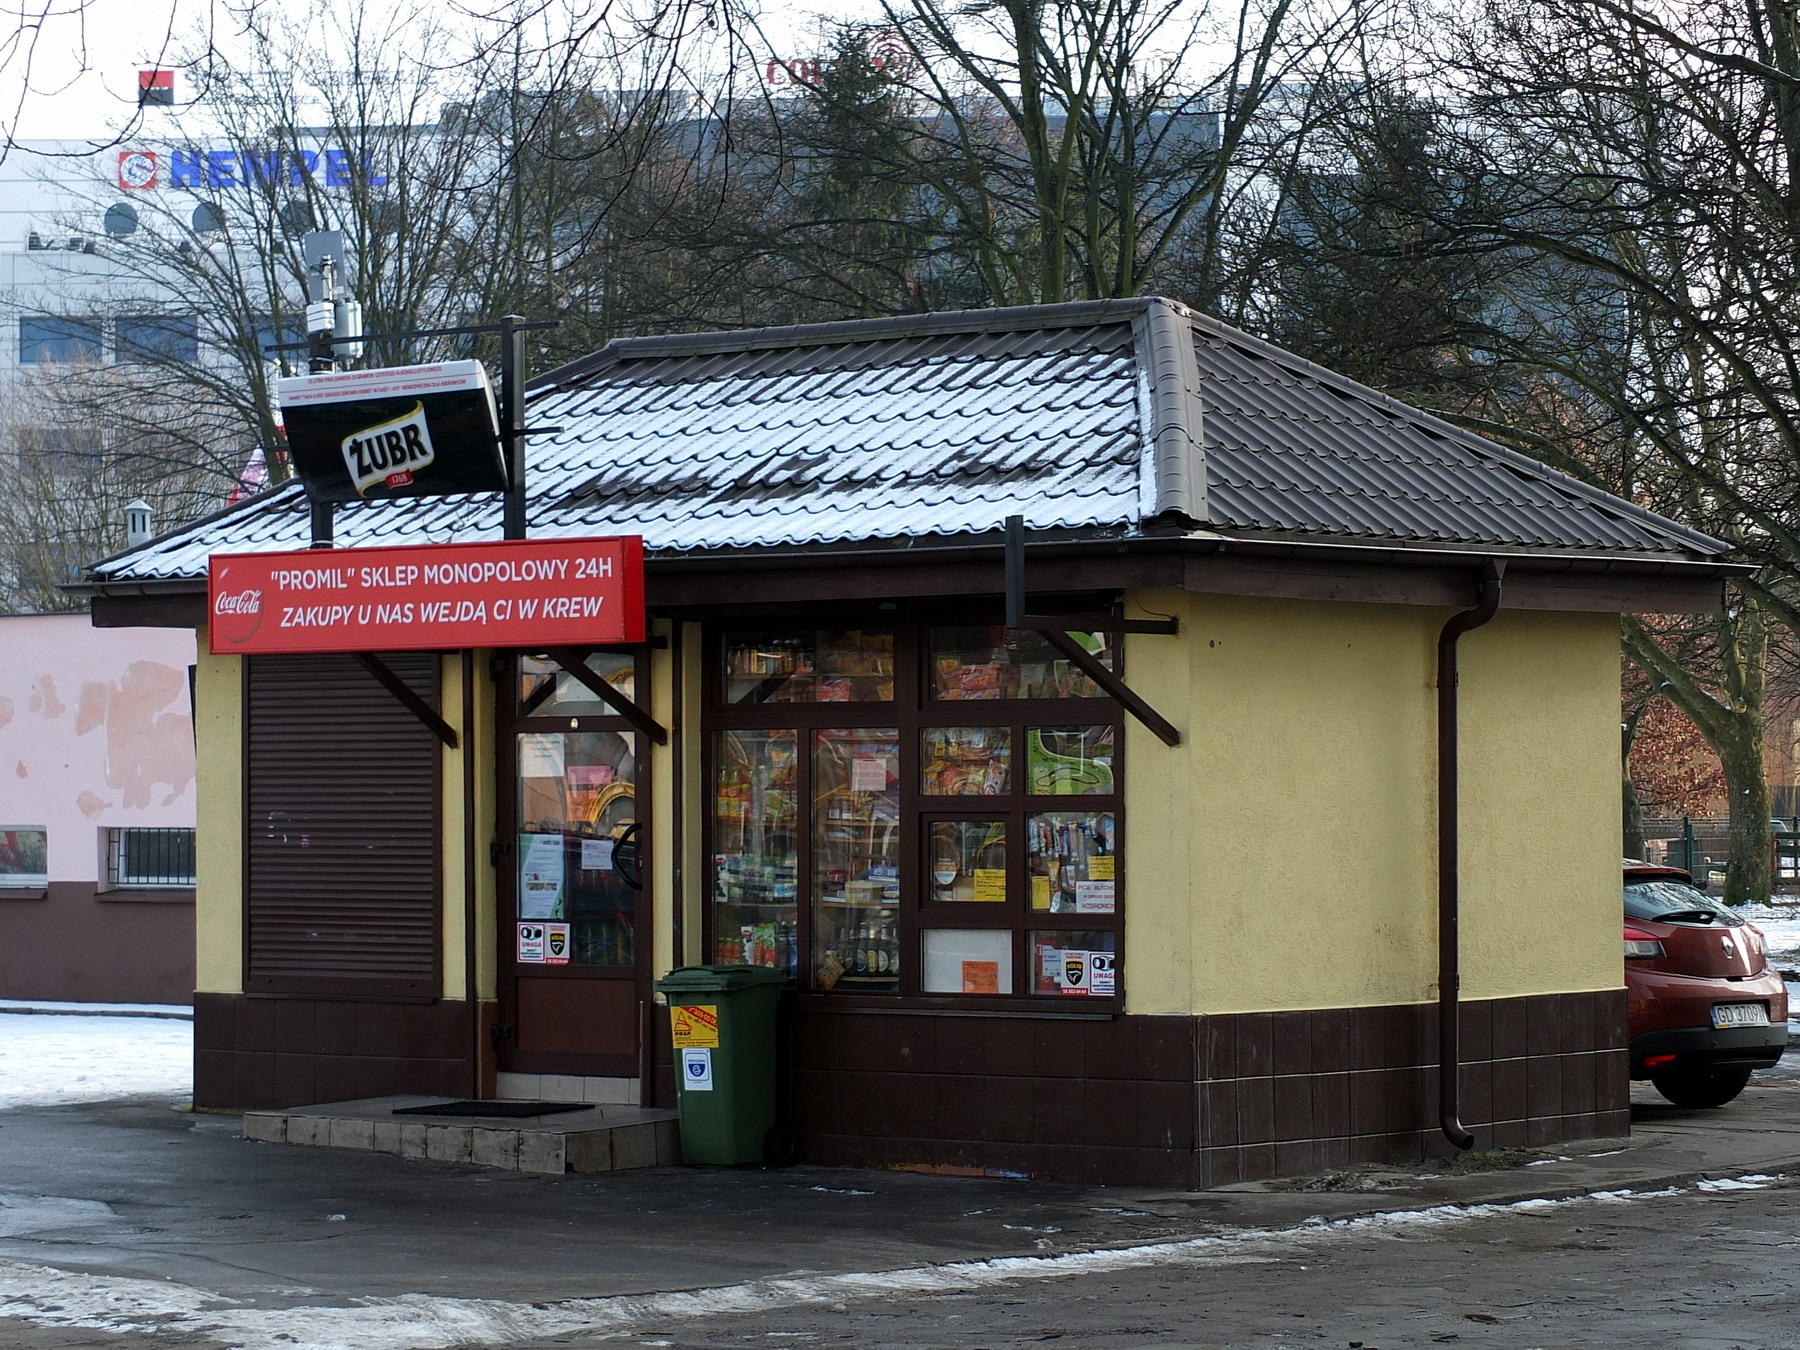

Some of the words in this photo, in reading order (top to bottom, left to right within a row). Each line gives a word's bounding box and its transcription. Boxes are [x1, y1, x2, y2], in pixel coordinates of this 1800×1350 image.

[171, 150, 387, 188] HEMPEL
[271, 567, 355, 591] "PROMIL"
[360, 564, 419, 588] SKLEP
[424, 558, 570, 585] MONOPOLOWY
[575, 556, 612, 580] 24H
[280, 604, 355, 628] ZAKUPY
[358, 604, 371, 625] U
[375, 602, 414, 624] NAS
[420, 599, 487, 626] WEJDĄ
[493, 598, 512, 620] CI
[518, 597, 540, 620] W
[542, 595, 604, 619] KREW
[1718, 1006, 1733, 1022] GD
